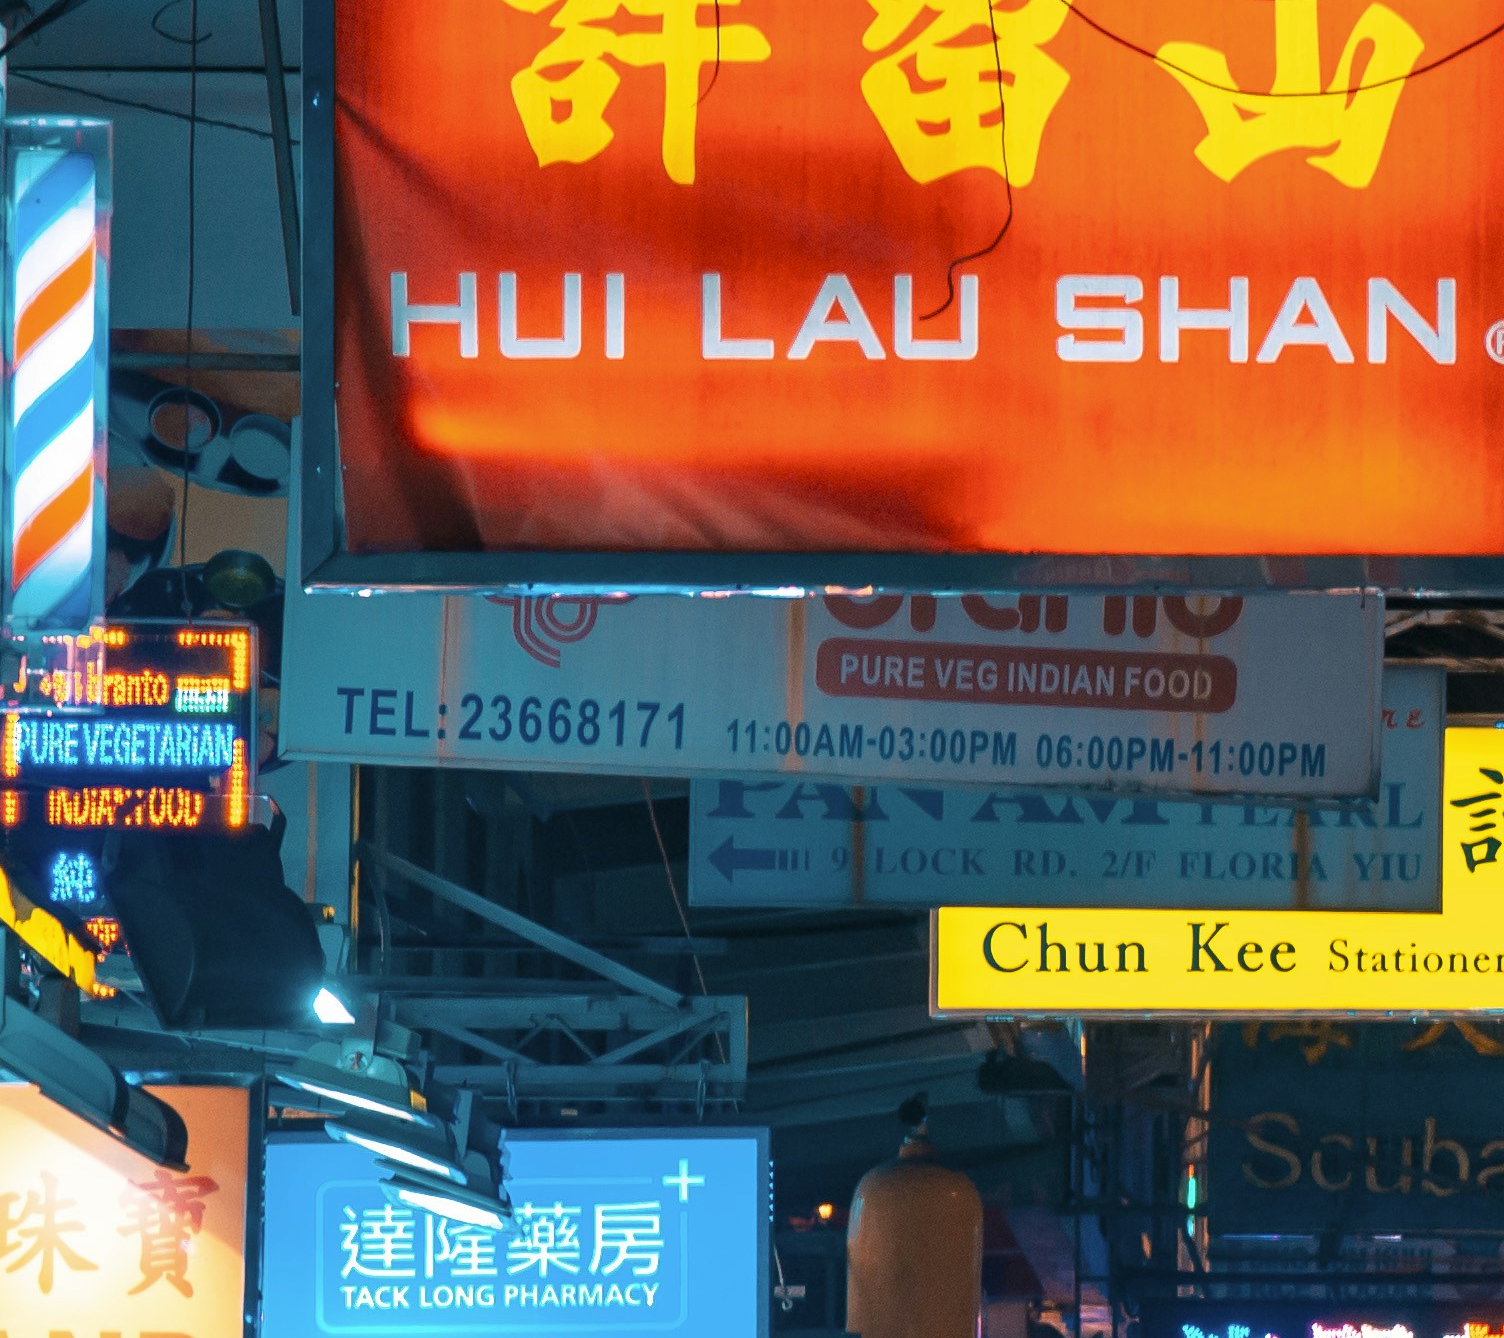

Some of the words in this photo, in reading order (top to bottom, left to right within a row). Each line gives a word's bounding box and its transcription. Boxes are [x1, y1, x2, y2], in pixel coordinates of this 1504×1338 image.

[390, 270, 627, 362] HUI
[702, 270, 978, 363] LAU
[1054, 274, 1458, 367] SHAN
[838, 654, 926, 689] PURE
[934, 658, 999, 692] VEG
[1006, 661, 1115, 698] INDIAN
[1124, 664, 1214, 701] FOOD
[16, 721, 79, 765] PURE
[726, 719, 1018, 767] 11:00AM-03:00PM
[1035, 732, 1328, 779] 06:00PM-11:00PM
[830, 845, 850, 874] 9
[874, 845, 986, 877] LOCK
[1012, 847, 1078, 879] RD.
[1100, 848, 1157, 880] 2/F
[1178, 850, 1329, 882] FLORIA
[1353, 851, 1423, 883] YIU
[982, 919, 1149, 974] Chun
[1188, 919, 1298, 974] Kee
[340, 1198, 665, 1282] 達隆藥房
[340, 1283, 411, 1309] TACK
[420, 1283, 495, 1309] LONG
[503, 1280, 660, 1309] PHARMACY
